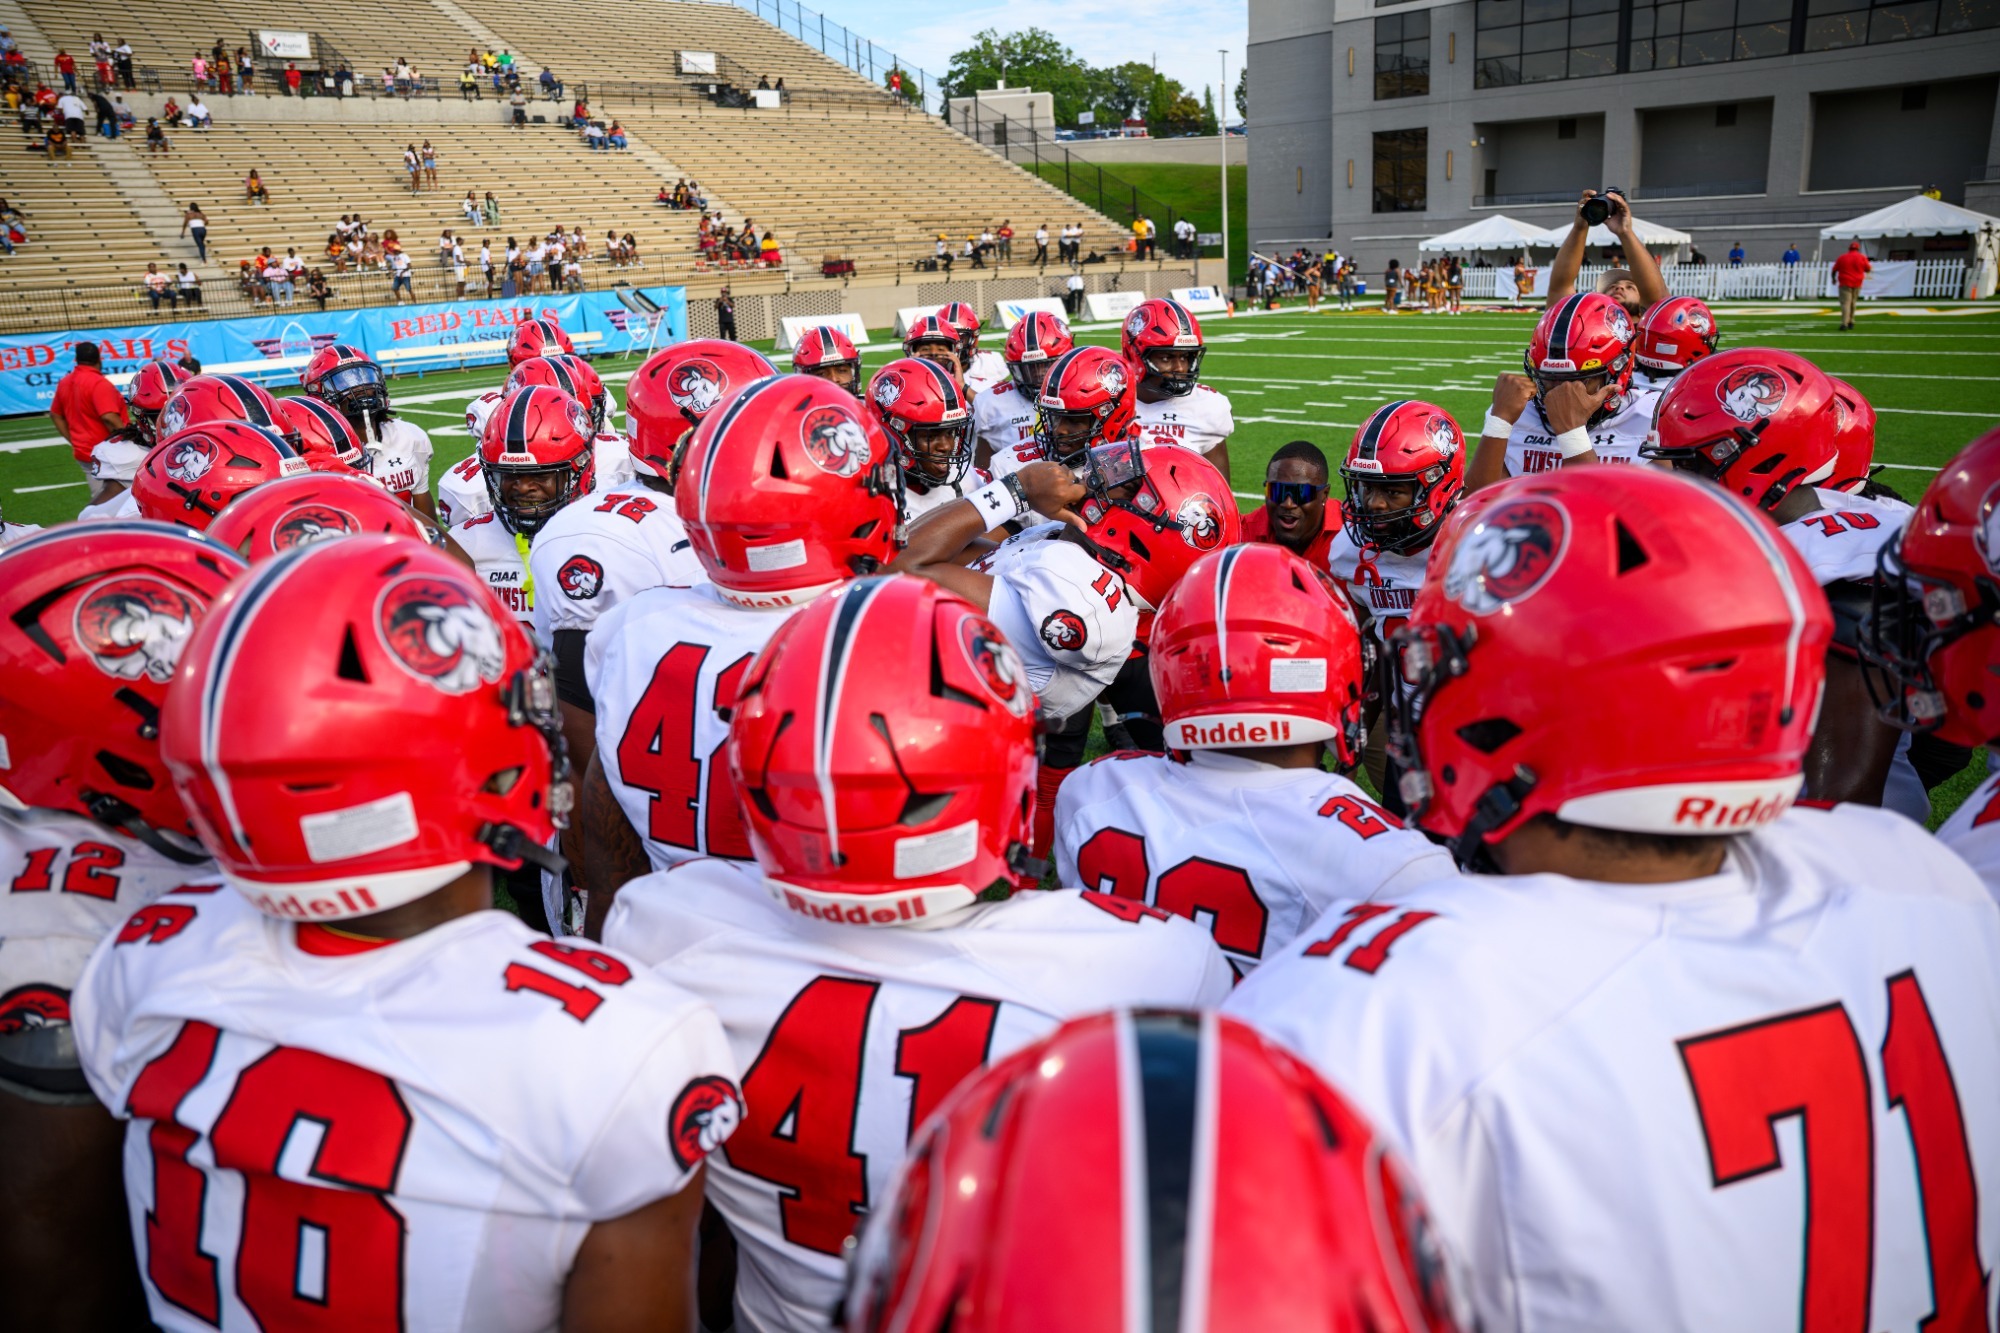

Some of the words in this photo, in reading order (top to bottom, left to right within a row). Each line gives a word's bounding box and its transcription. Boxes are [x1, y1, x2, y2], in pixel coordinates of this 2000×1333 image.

[391, 311, 461, 341] RED
[468, 308, 558, 327] TAIS
[0, 344, 55, 371] ED
[65, 338, 187, 360] AILS
[1524, 435, 1552, 445] CIAA
[1353, 460, 1377, 470] Riddell
[593, 493, 658, 524] 72
[1800, 511, 1881, 538] 70
[490, 571, 519, 583] CIAA
[1181, 720, 1290, 745] Riddell
[10, 841, 125, 902] 12
[785, 890, 926, 926] Riddell
[503, 938, 633, 1023] 16
[722, 974, 1002, 1257] 41
[1675, 967, 1991, 1333] 71
[126, 1019, 413, 1333] 16
